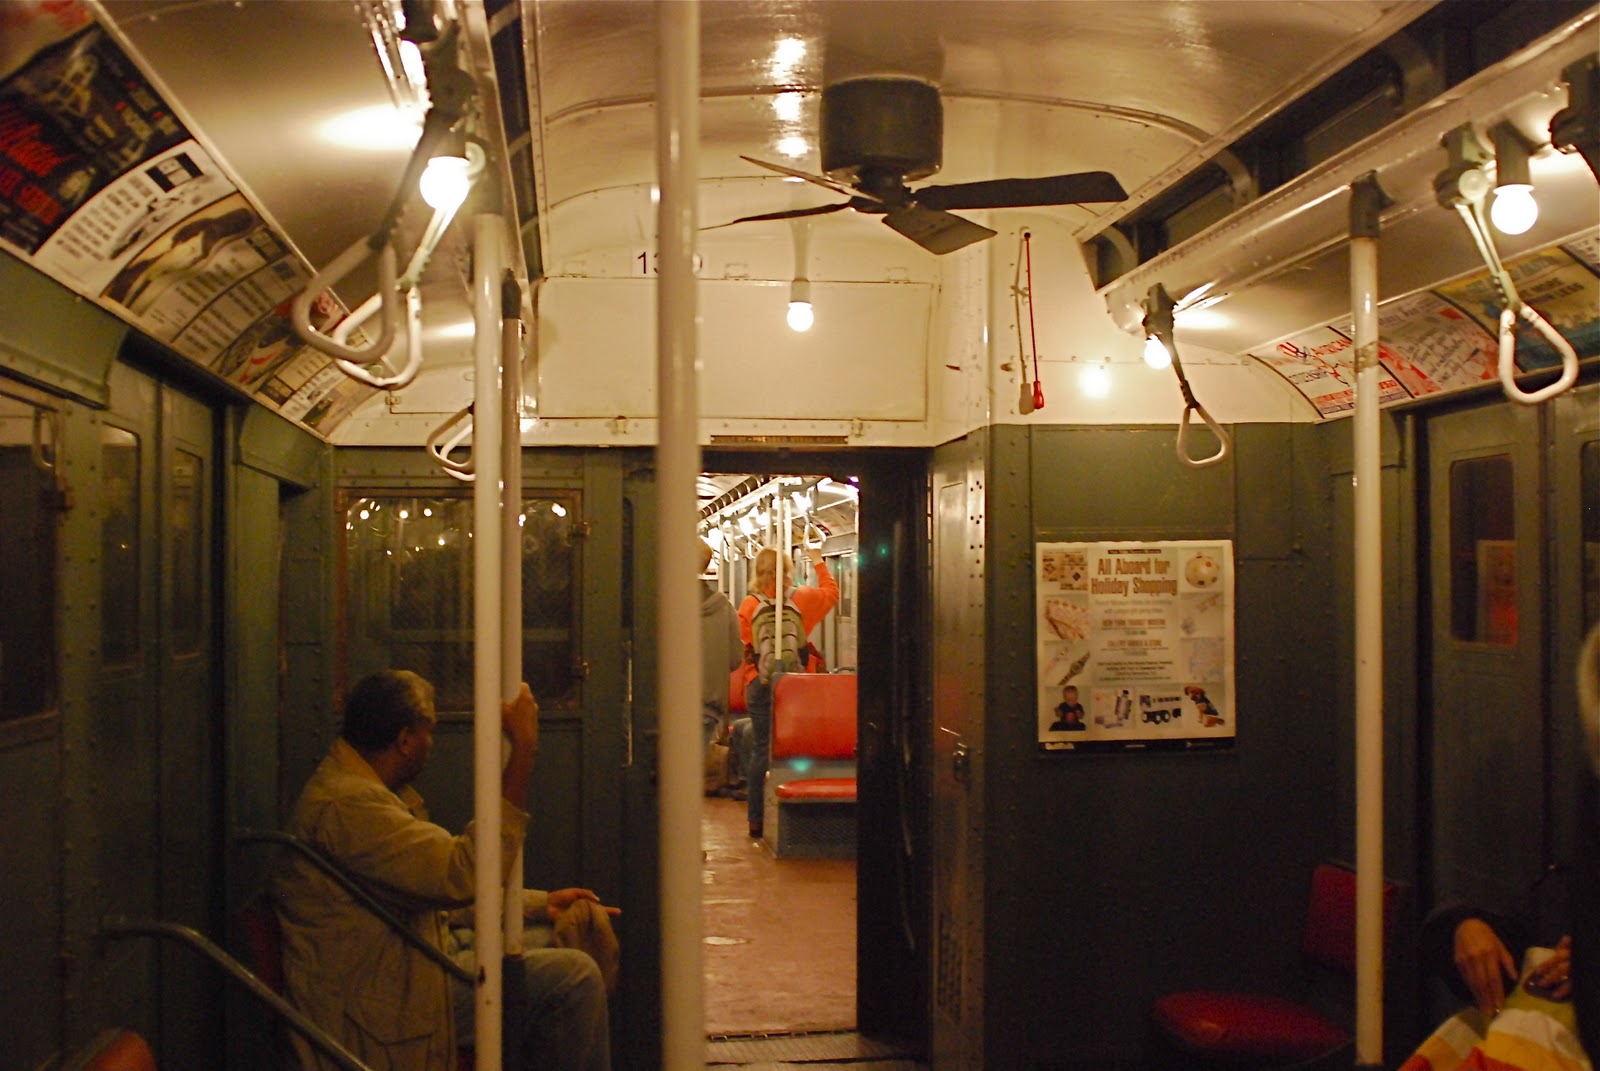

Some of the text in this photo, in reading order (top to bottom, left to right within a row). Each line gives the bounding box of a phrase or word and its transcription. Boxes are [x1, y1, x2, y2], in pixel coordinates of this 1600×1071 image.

[1097, 558, 1170, 575] All Aboard for
[1091, 576, 1177, 597] Holiday Shopping
